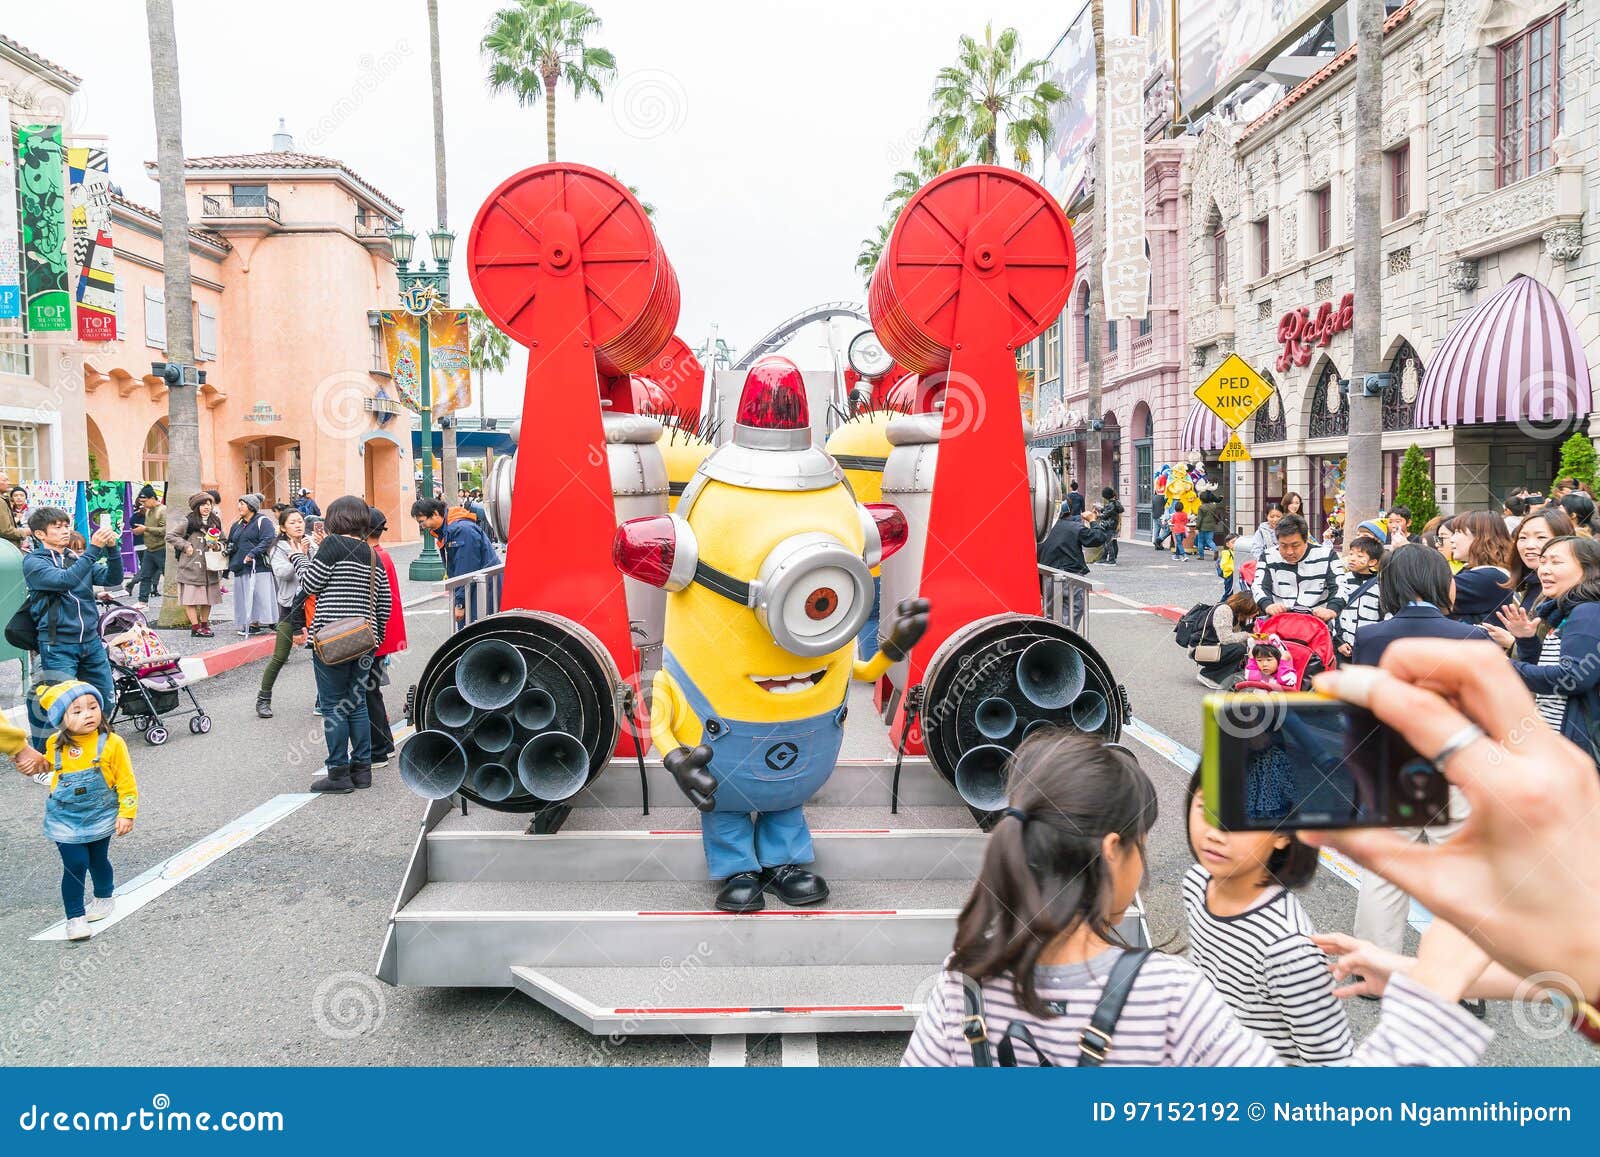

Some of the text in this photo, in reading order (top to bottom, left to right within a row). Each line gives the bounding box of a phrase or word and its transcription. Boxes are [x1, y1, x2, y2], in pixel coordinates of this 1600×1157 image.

[1112, 57, 1140, 313] MONTMARTRE
[33, 305, 65, 318] TOP
[82, 316, 112, 329] TOP
[1219, 377, 1250, 389] PED
[1216, 395, 1253, 408] XING
[1229, 442, 1242, 450] BUS
[1226, 450, 1245, 458] STOP
